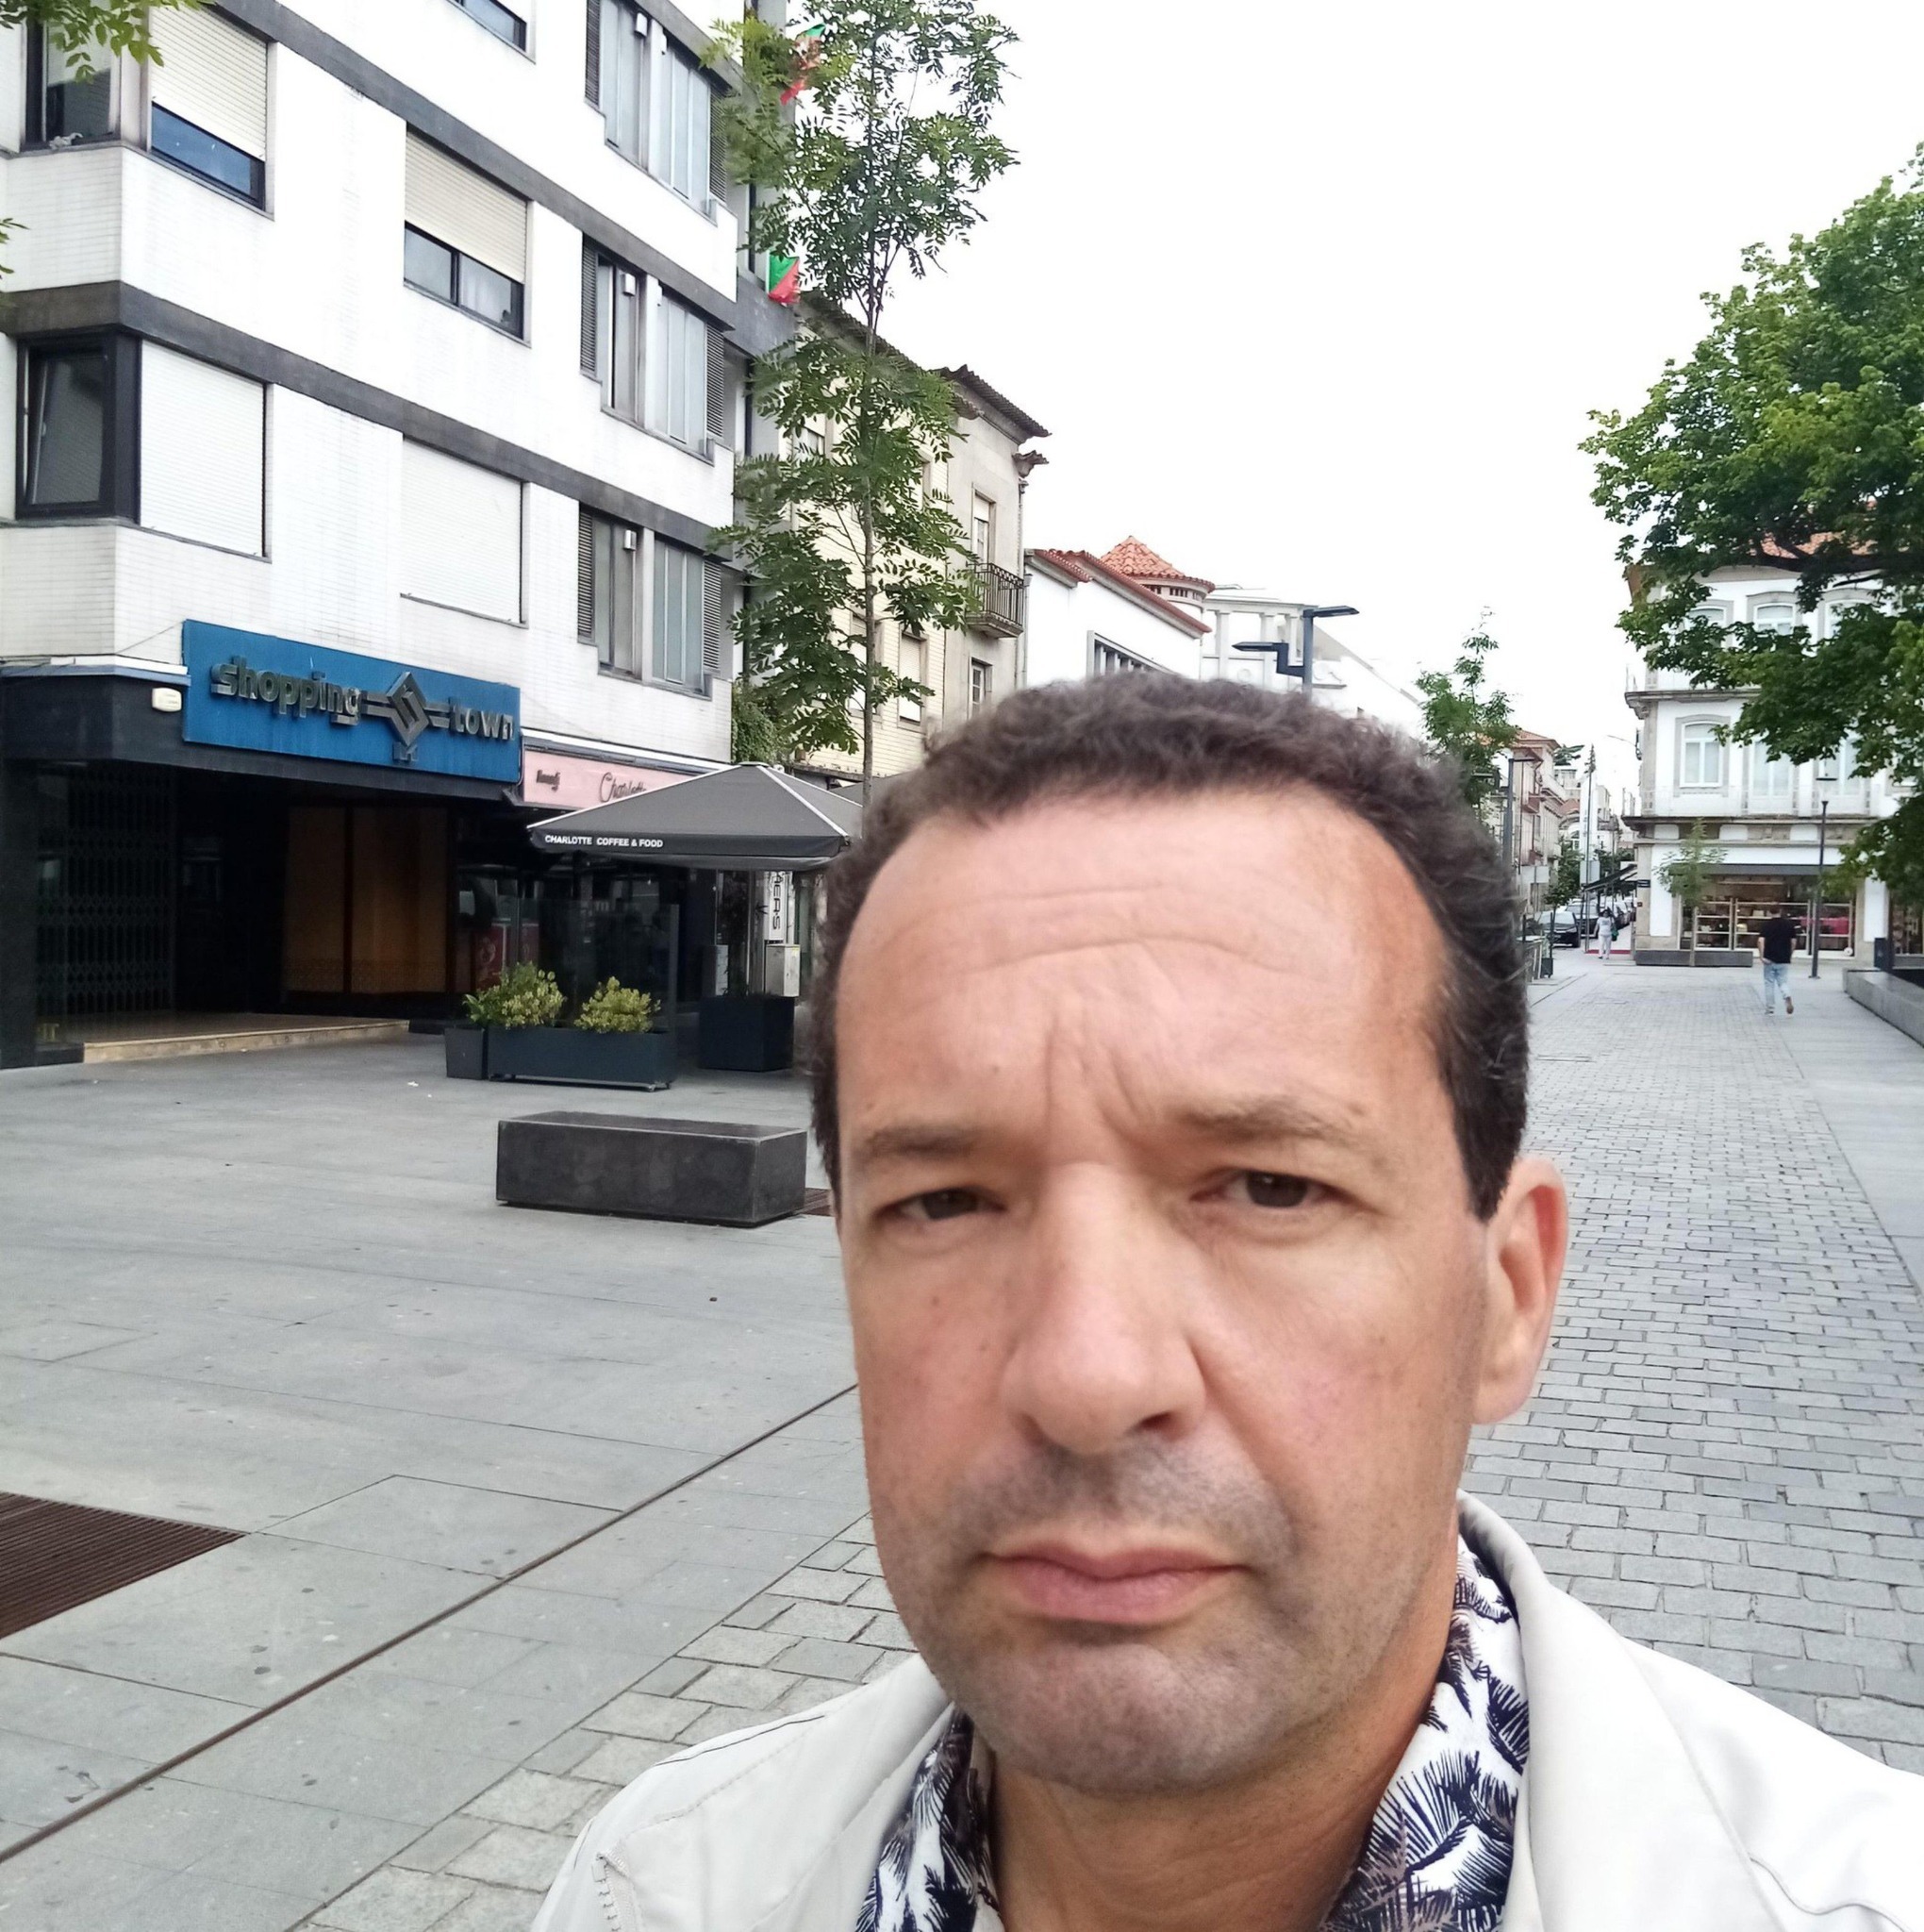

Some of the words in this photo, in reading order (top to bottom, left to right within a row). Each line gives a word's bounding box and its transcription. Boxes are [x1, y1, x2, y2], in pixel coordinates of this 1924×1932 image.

[210, 655, 361, 726] shopping
[450, 696, 514, 741] town
[544, 835, 592, 845] CHARLOTTE
[596, 837, 630, 847] COFFEE
[631, 839, 638, 847] &
[639, 839, 664, 848] FOOD
